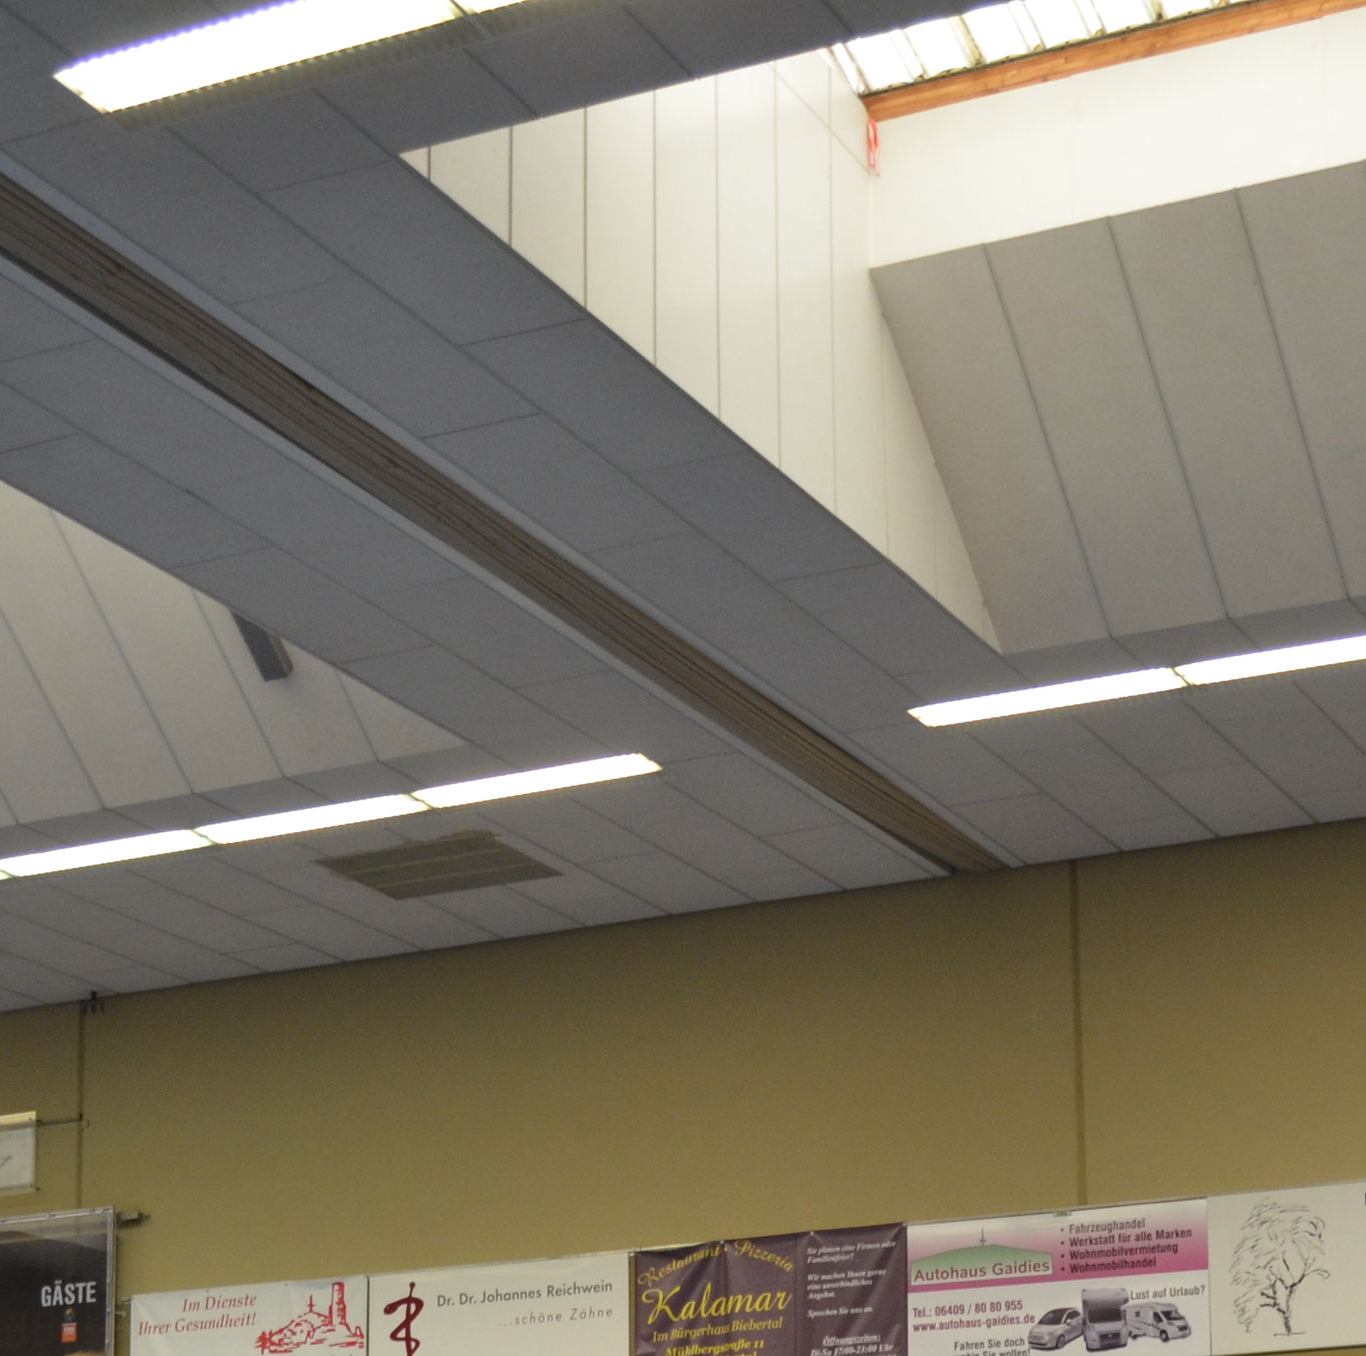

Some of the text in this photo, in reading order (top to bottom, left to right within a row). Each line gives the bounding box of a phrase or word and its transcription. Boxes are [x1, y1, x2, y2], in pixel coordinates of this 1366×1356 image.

[1069, 1219, 1146, 1234] Fahrzeughandel
[1069, 1228, 1192, 1247] Werkstatt für alle Marken
[1070, 1243, 1178, 1260] Wohnmobilvermietung
[637, 1240, 794, 1286] Restaurant Pizzeria
[915, 1260, 1050, 1282] Autohaus Gaidies
[1070, 1257, 1156, 1273] Wohnmobilhandel
[41, 1280, 96, 1307] GÄSTE
[437, 1280, 613, 1307] Dr. Dr. Johannes Reichwein
[1131, 1285, 1205, 1300] Lust auf Urlaub?
[183, 1295, 256, 1312] Im Dienste
[642, 1282, 792, 1325] Kalamar
[913, 1308, 932, 1317] Tel.:
[935, 1305, 965, 1317] 06409
[975, 1303, 987, 1312] 80
[989, 1302, 1001, 1312] 80
[1005, 1300, 1023, 1311] 955
[570, 1307, 613, 1321] Zähne
[138, 1313, 256, 1335] Ihrer Gesundheit!
[653, 1316, 783, 1343] Im Bürgerhaus Biebertal
[913, 1314, 1035, 1332] www.autohaus-gaidies.de
[754, 1340, 764, 1349] 11
[955, 1337, 1024, 1350] Fahren Sie doch
